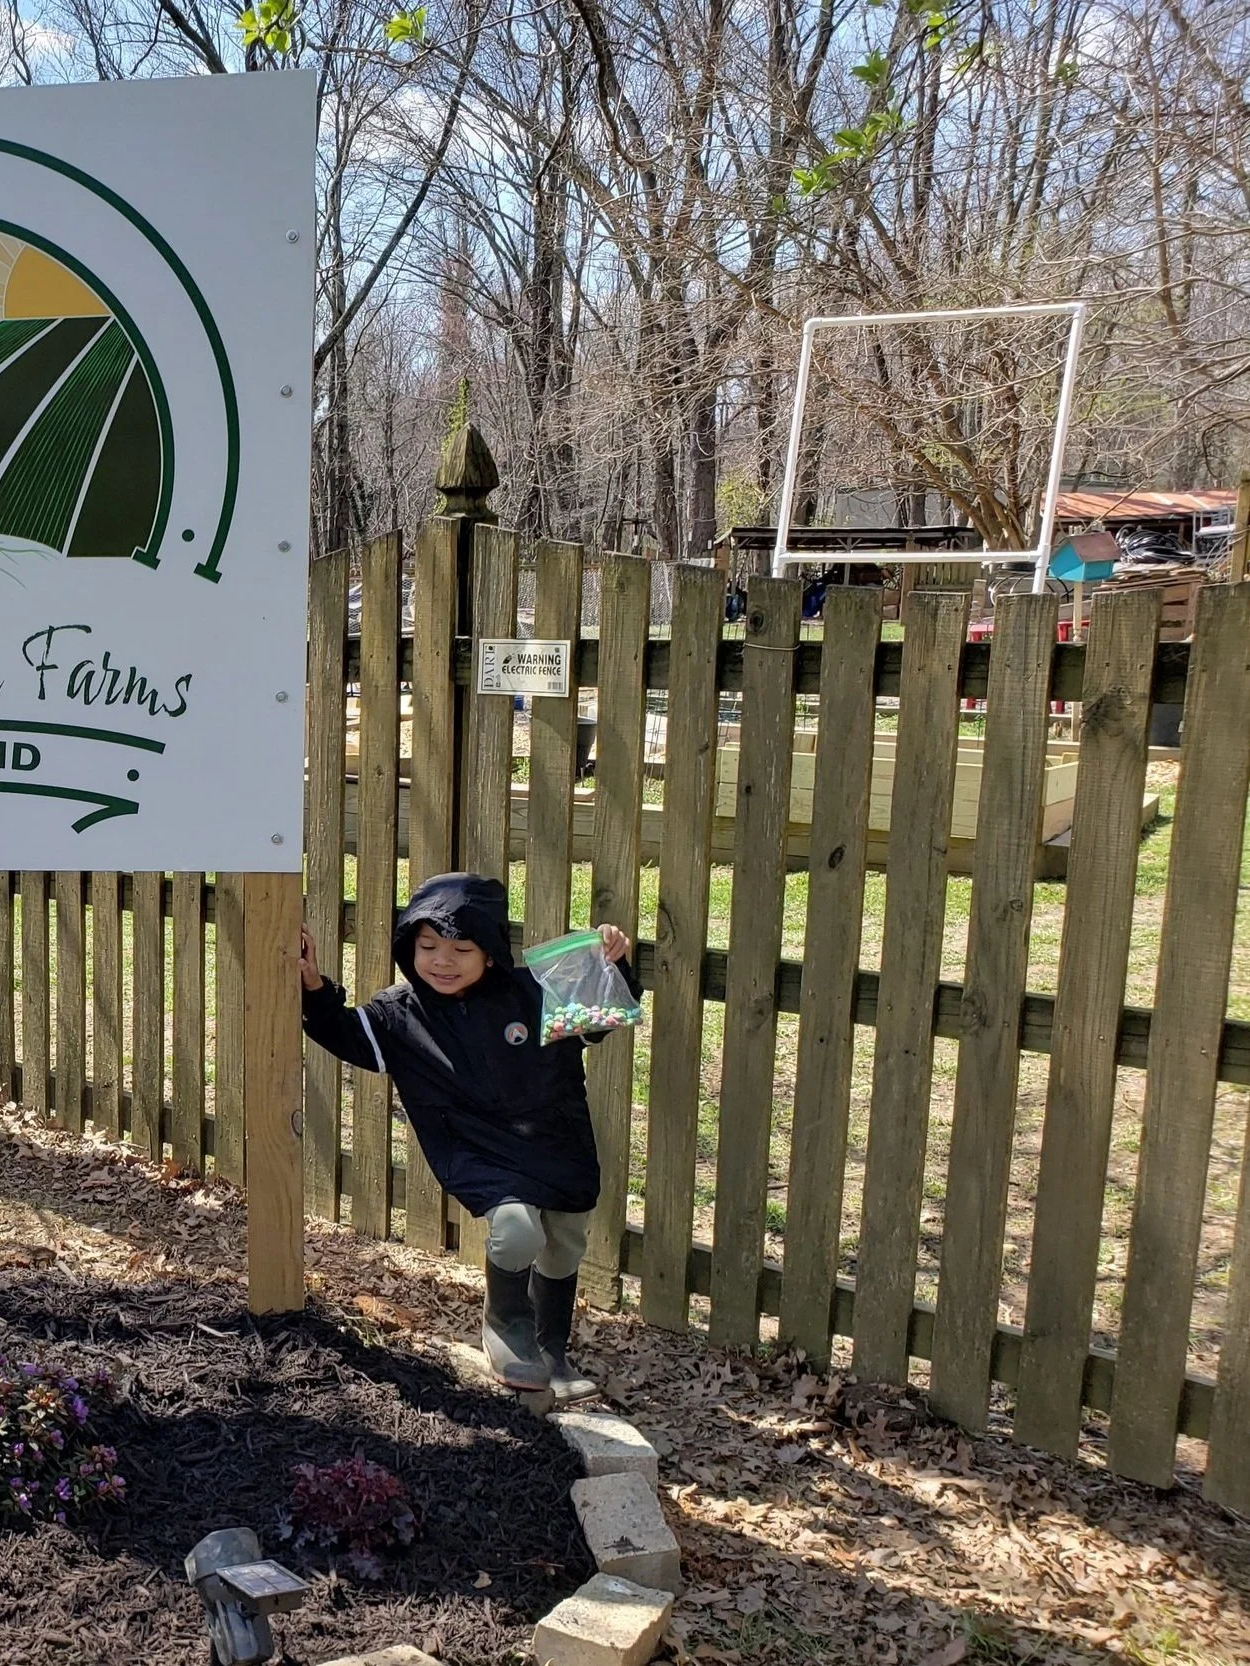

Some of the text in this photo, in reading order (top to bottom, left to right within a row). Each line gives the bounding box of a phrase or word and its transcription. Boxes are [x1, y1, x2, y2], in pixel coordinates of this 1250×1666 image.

[517, 654, 561, 665] WARNING
[22, 624, 193, 717] Farms
[502, 665, 561, 676] ELECTRIC FENCE
